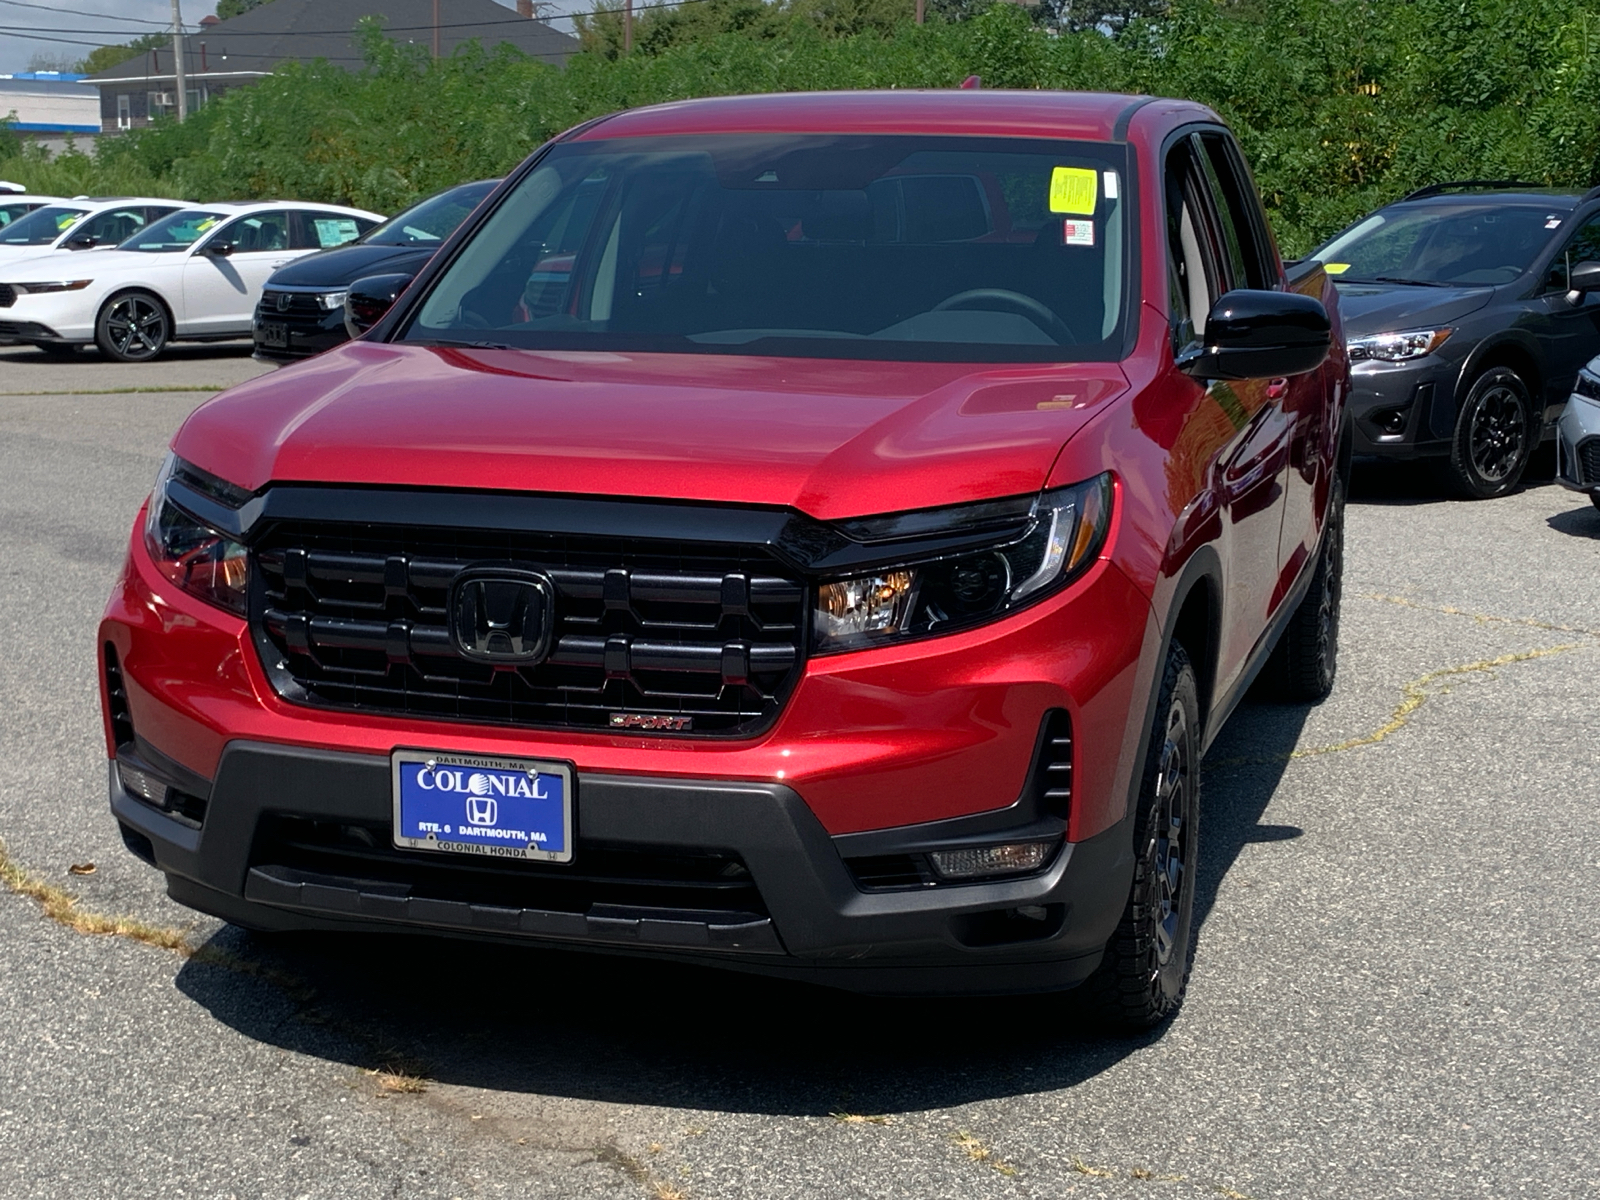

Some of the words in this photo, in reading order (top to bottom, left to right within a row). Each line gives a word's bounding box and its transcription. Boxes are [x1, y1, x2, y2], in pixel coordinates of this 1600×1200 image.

[610, 714, 692, 730] SPORT
[436, 756, 506, 769] DARTMOUTH,
[508, 762, 526, 770] MA
[416, 769, 548, 799] COLONIAL
[418, 822, 442, 833] RTE.
[443, 825, 452, 833] 6
[458, 826, 528, 842] DARTMOUTH,
[530, 832, 548, 842] MA
[437, 841, 488, 855] COLONIAL
[490, 847, 527, 858] HONDA
